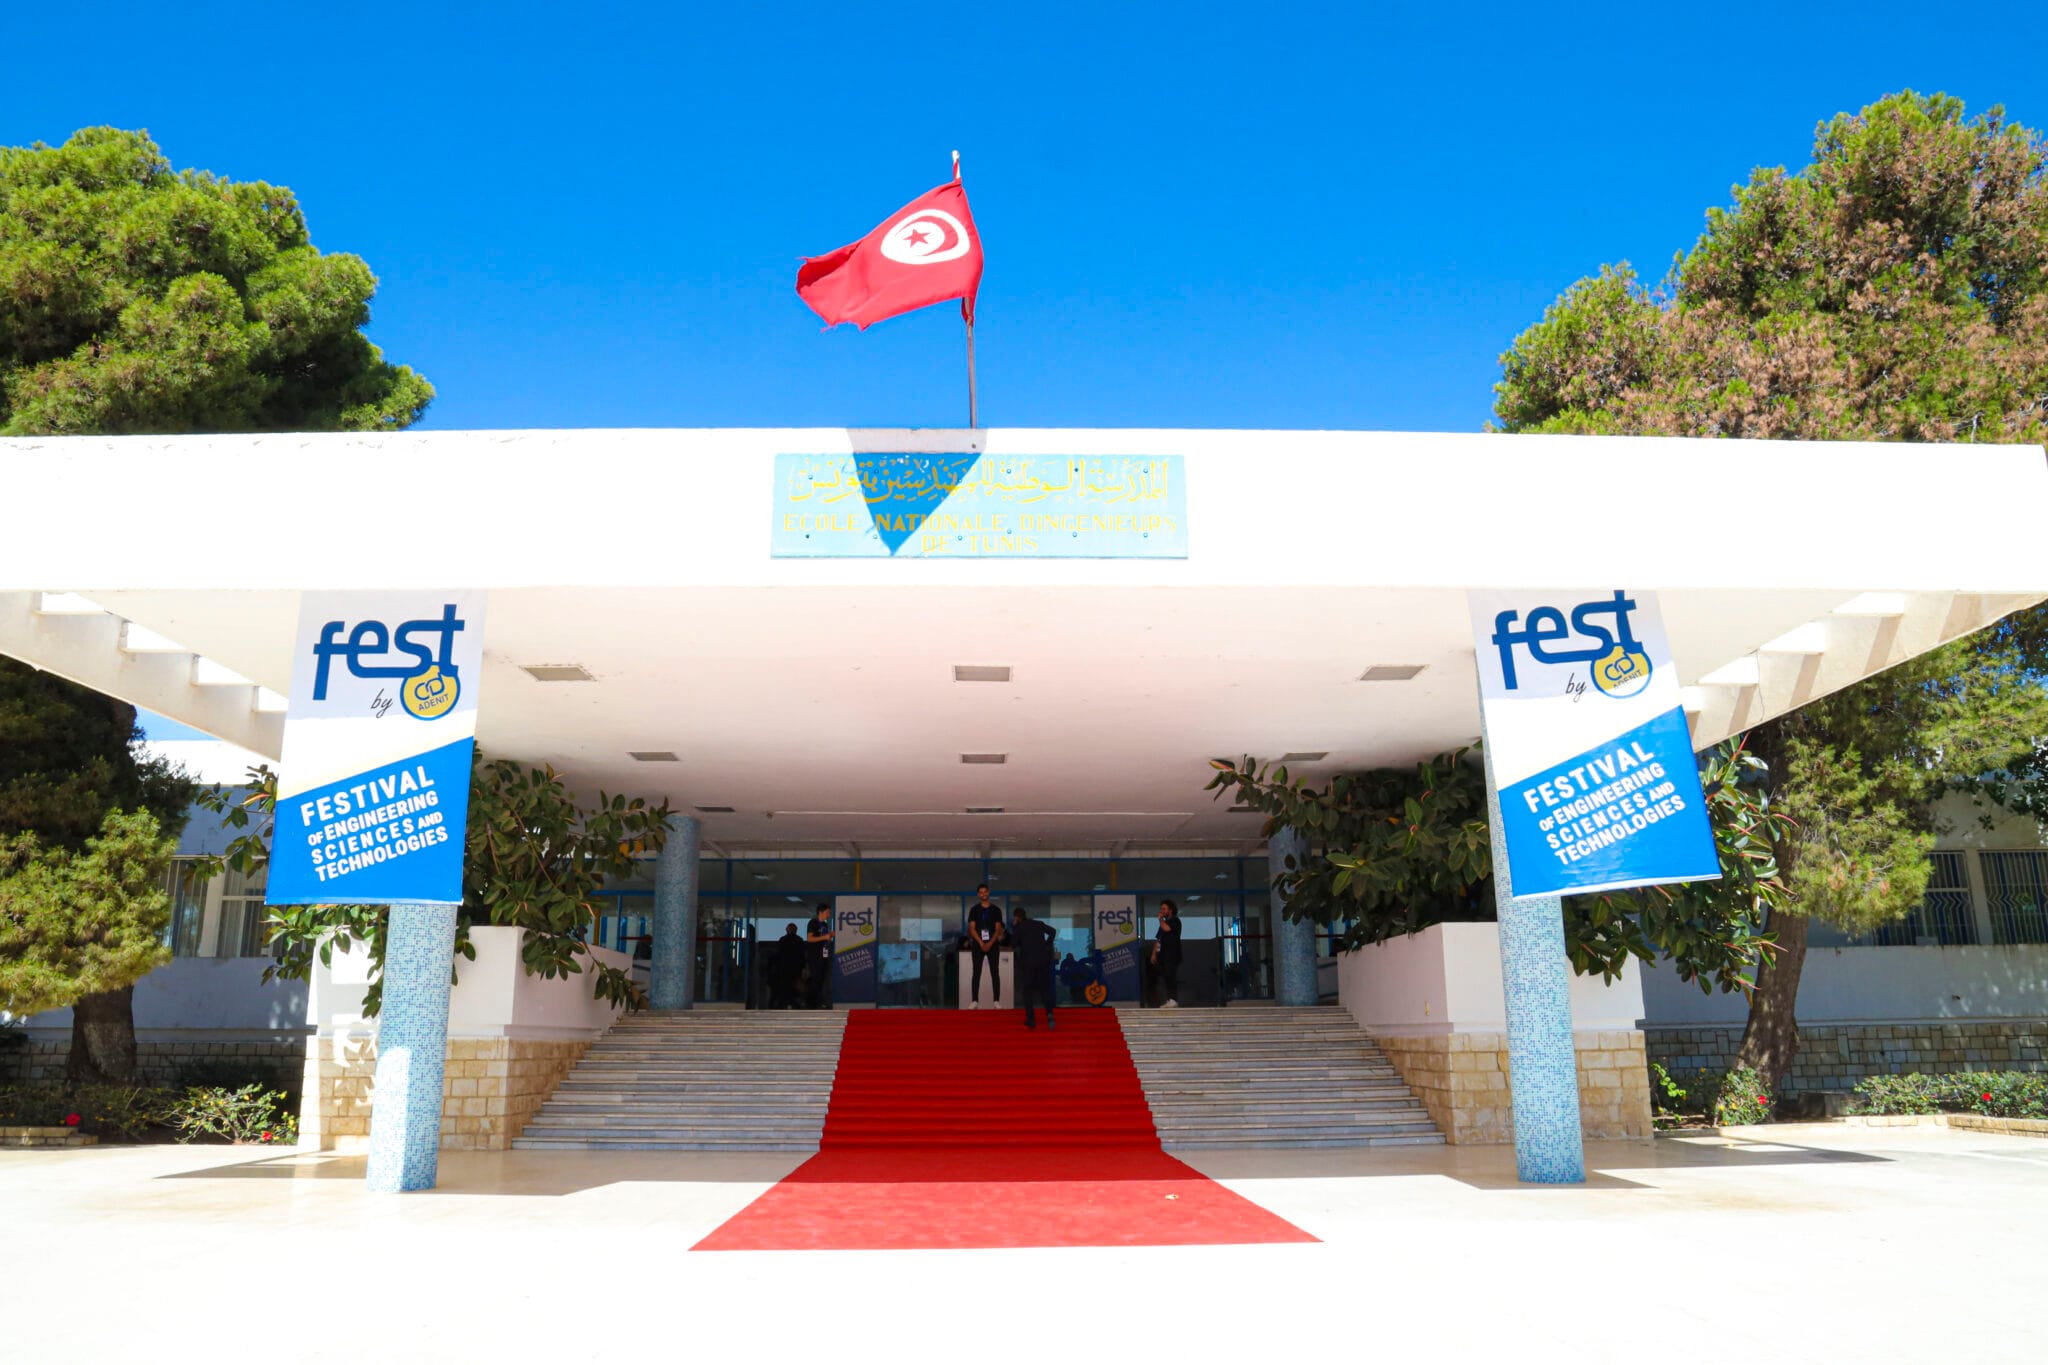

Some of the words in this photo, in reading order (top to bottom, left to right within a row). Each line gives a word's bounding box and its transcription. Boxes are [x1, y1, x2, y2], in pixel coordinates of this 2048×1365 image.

[783, 513, 860, 532] ECOLE
[875, 513, 1006, 532] NATIONALE
[921, 534, 950, 553] DE
[966, 534, 1039, 553] TUNIS
[313, 604, 465, 701] fest
[1491, 589, 1643, 690] fest
[371, 688, 394, 719] by
[418, 693, 449, 711] ADENIT
[1565, 672, 1587, 703] by
[300, 766, 434, 827] FESTIVAL
[1522, 741, 1654, 814] FESTIVAL
[1538, 816, 1556, 833] OF
[1553, 762, 1665, 826] ENGINEERING
[307, 830, 324, 847] OF
[324, 790, 439, 842] ENGINEERING
[311, 817, 415, 866] SCIENCES
[417, 811, 443, 830] AND
[1546, 794, 1647, 849] SCIENCES
[1650, 781, 1675, 801] AND
[1554, 795, 1686, 866] TECHNOLOGIES
[315, 825, 448, 882] TECHNOLOGIES
[838, 907, 873, 931] fest
[1097, 907, 1133, 930] fest
